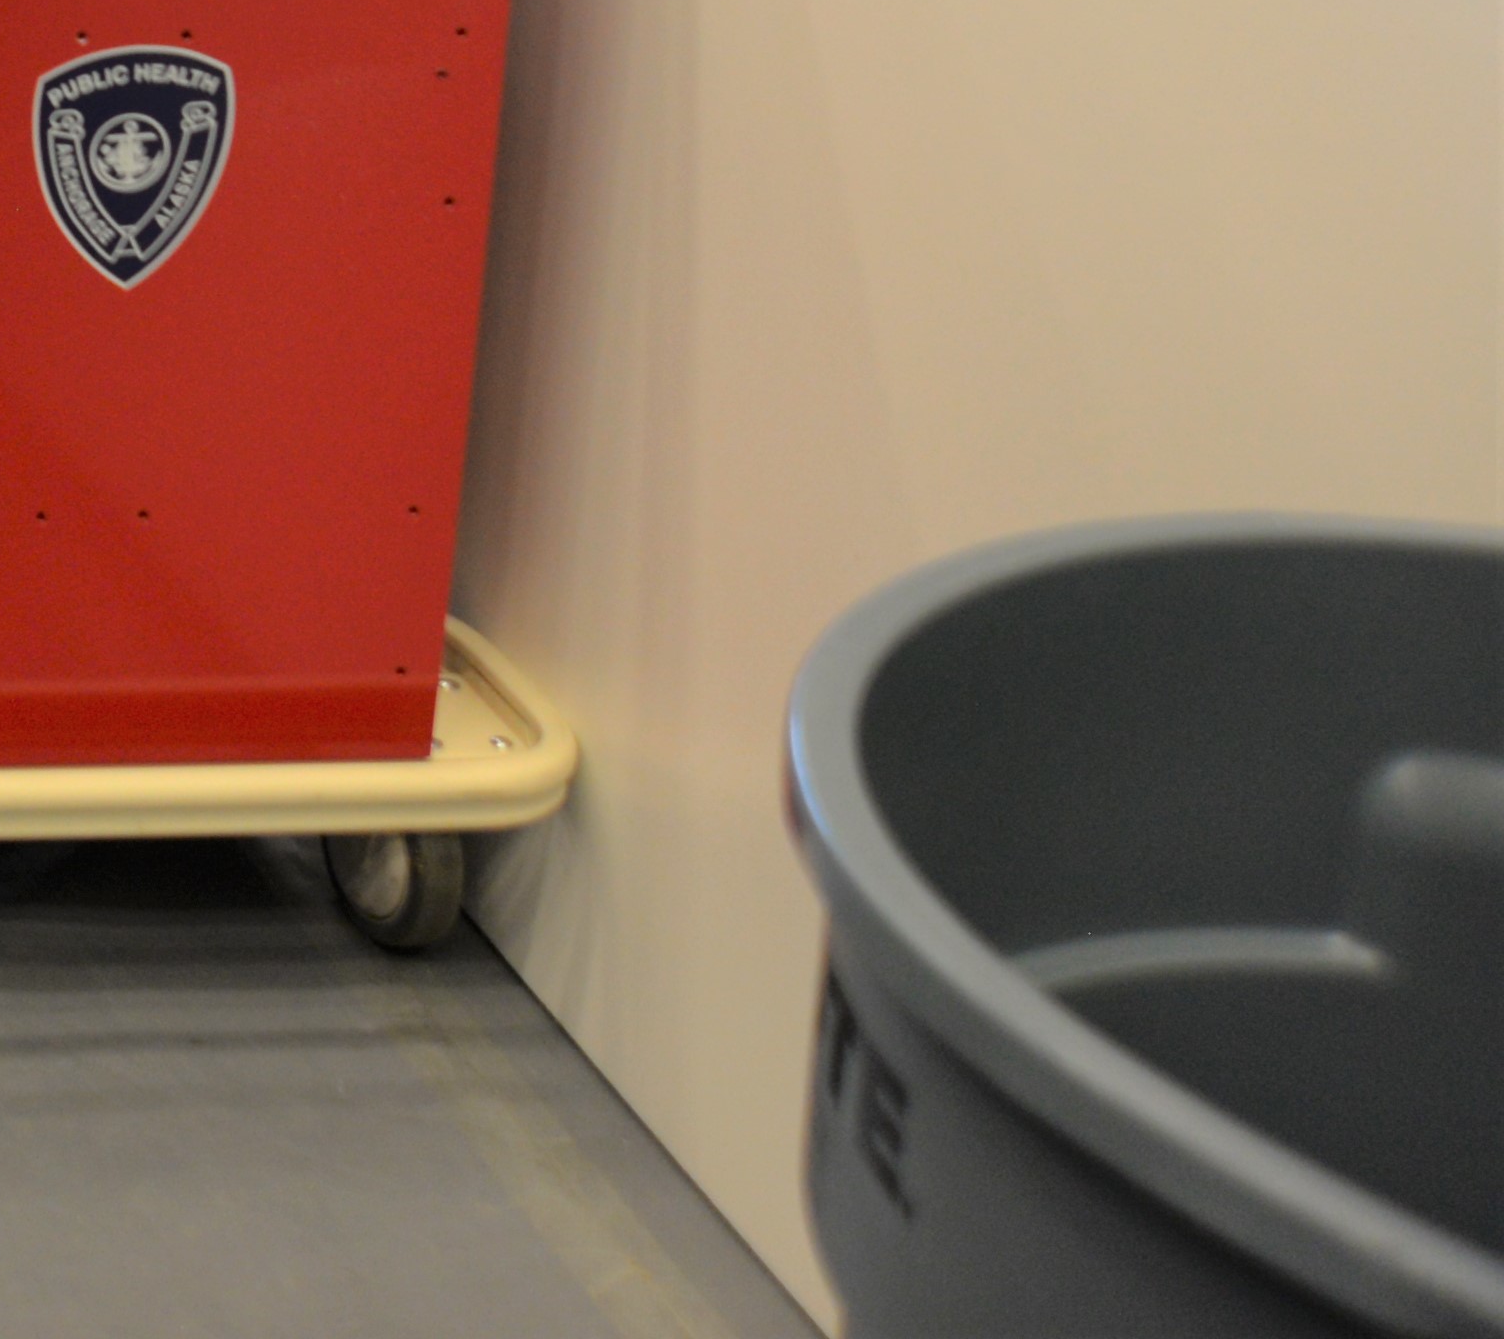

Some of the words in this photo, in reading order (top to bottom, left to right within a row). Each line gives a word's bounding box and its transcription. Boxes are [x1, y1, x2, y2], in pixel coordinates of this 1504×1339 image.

[46, 64, 130, 108] PUBLIC
[133, 63, 220, 96] HEALTH
[54, 142, 116, 247] ANCHORAGE
[154, 159, 201, 232] ALASKA
